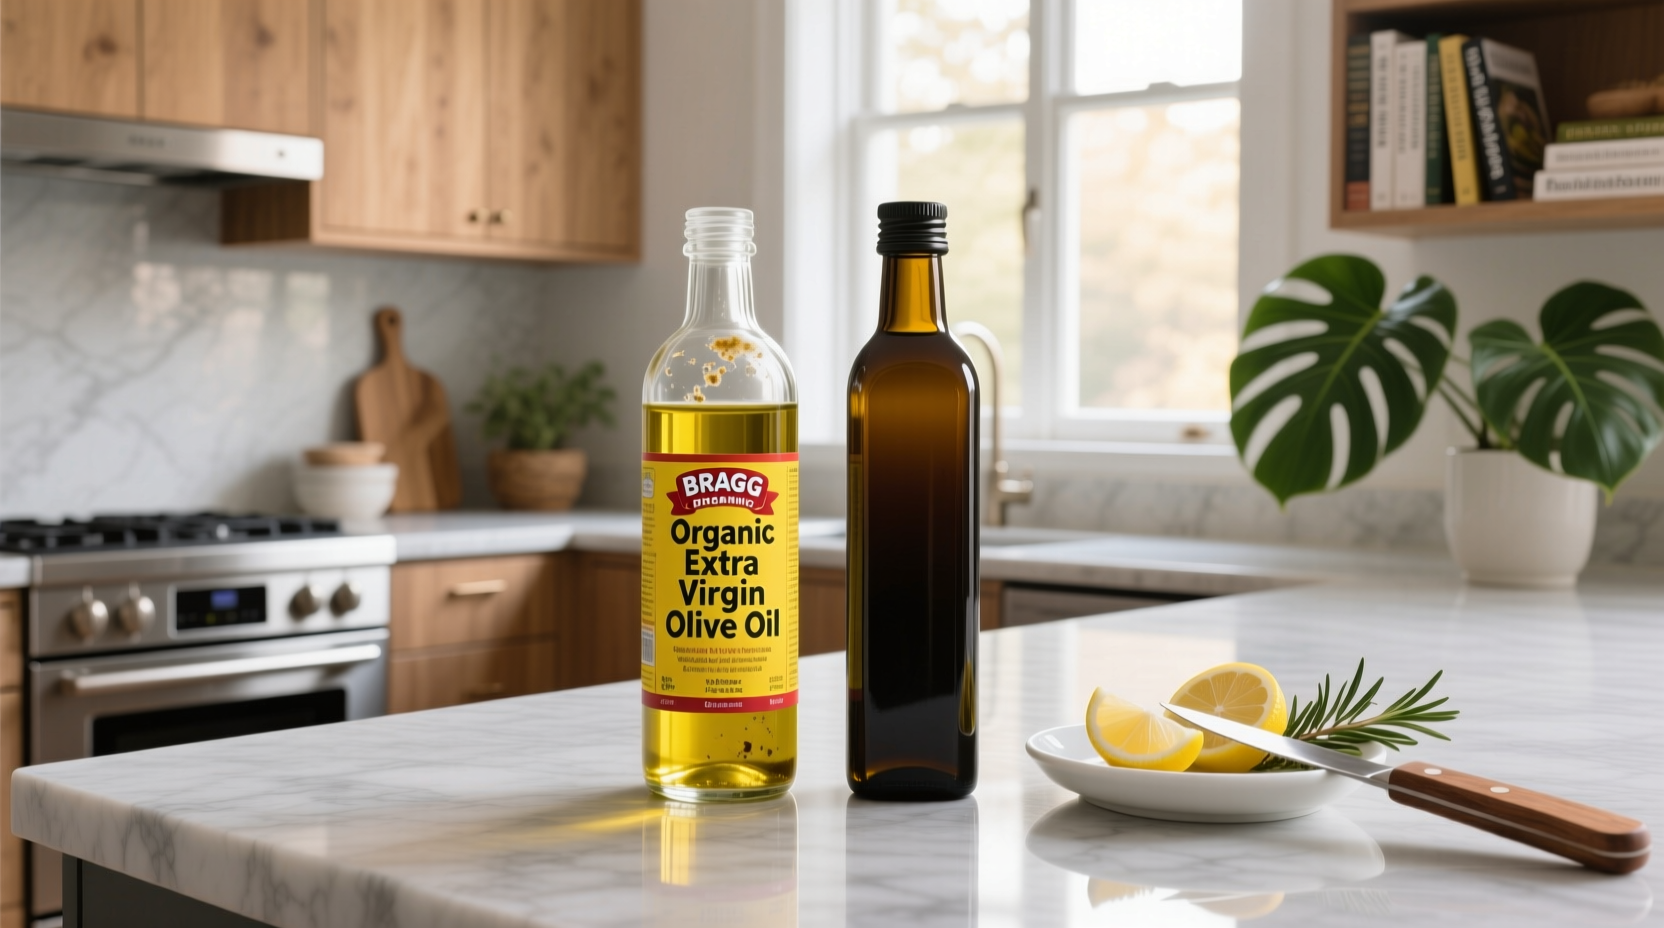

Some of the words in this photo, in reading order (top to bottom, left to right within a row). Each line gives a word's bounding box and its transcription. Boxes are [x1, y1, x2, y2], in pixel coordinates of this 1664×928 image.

[682, 472, 764, 497] BRAGG
[671, 518, 775, 551] Organic
[685, 549, 759, 576] Extra
[678, 579, 765, 613] Virgin
[666, 610, 737, 639] Olive
[745, 608, 780, 638] Oil
